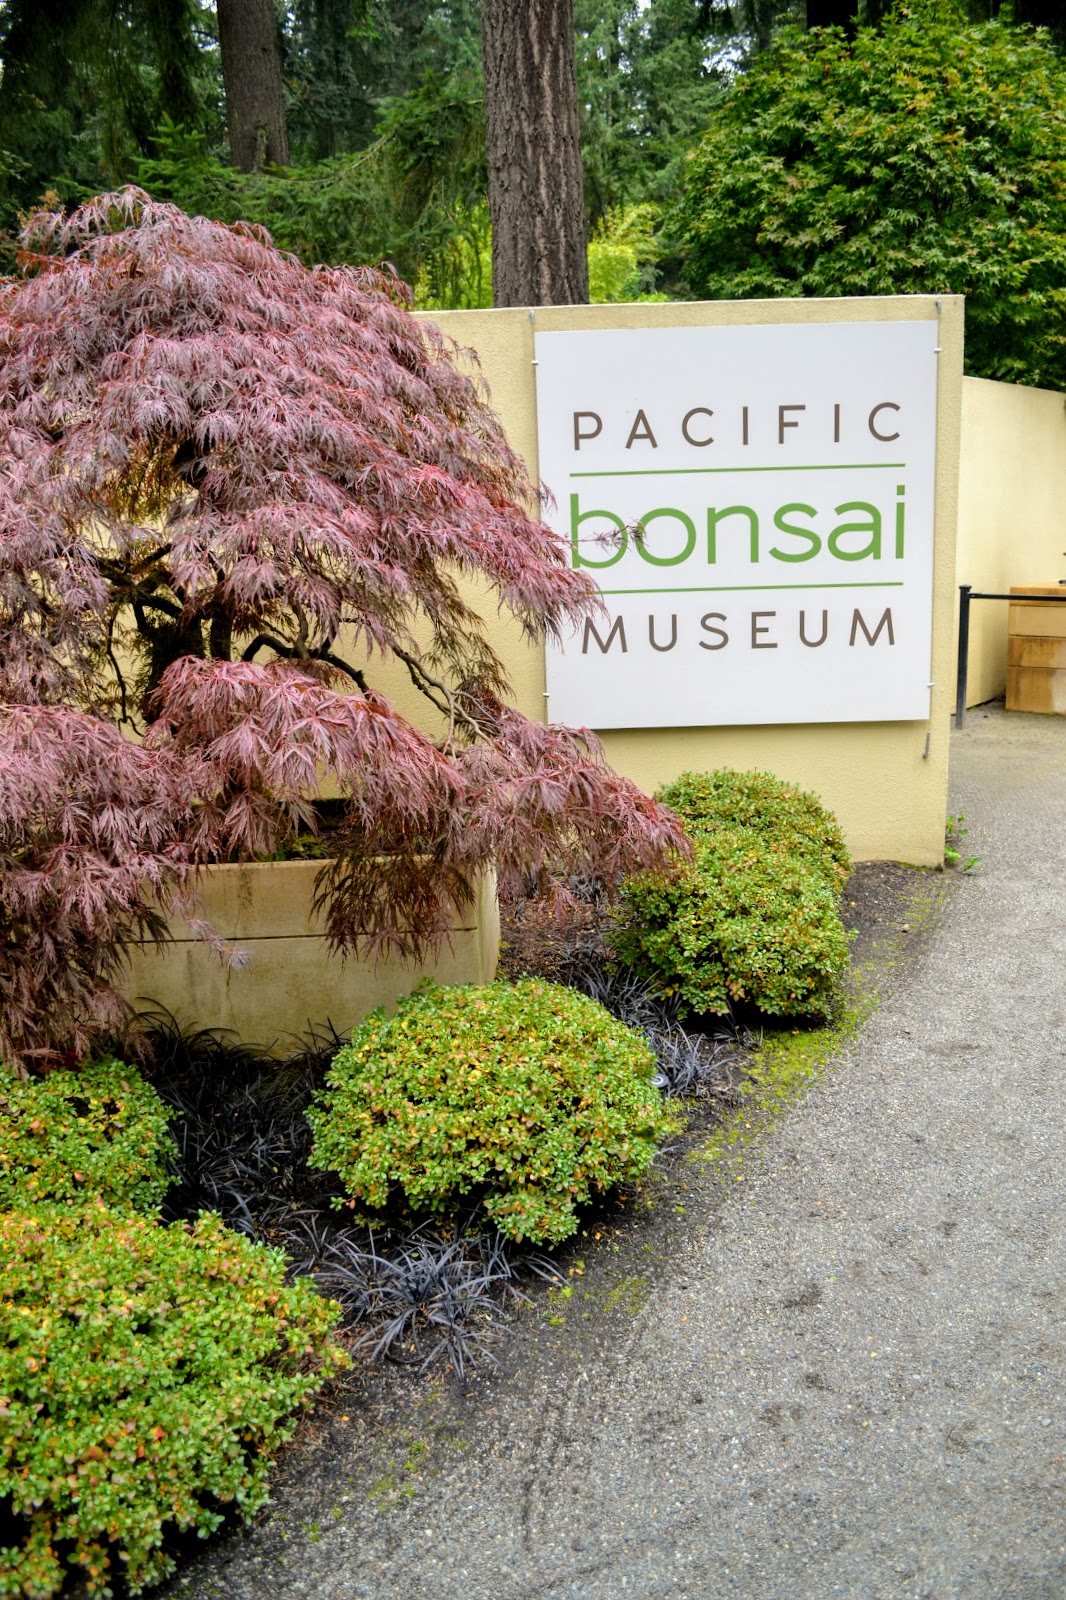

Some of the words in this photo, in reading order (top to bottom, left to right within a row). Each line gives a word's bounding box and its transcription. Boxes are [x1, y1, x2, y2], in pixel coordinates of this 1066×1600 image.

[573, 402, 901, 450] PACIFIC
[570, 484, 906, 569] bonsai
[581, 607, 895, 655] MUSEUM
